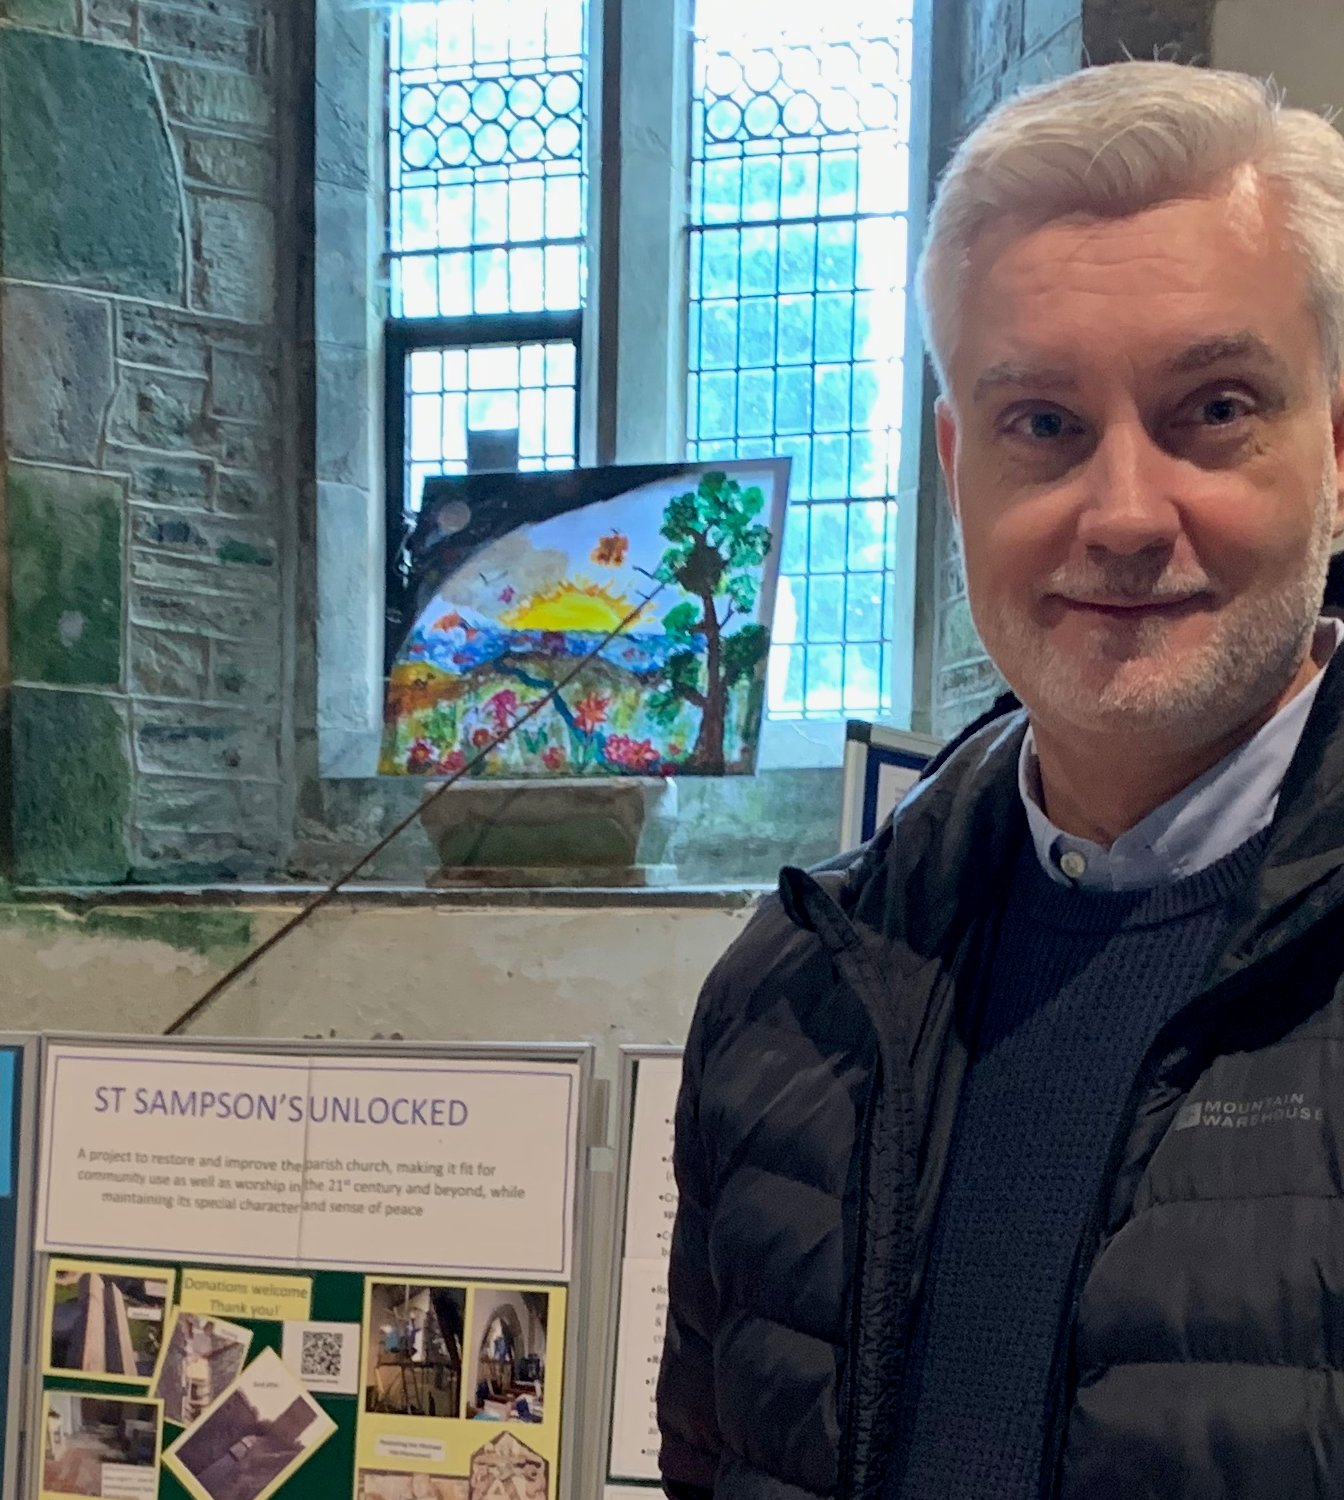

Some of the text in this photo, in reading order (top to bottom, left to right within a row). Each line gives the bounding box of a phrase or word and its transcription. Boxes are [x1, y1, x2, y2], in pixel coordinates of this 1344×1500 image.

[94, 1085, 469, 1127] ST SAMPSON'S UNLOCKED
[77, 1147, 497, 1178] A project to restore and improve the parish church, making it fit for
[77, 1169, 146, 1186] community
[149, 1174, 171, 1186] use
[173, 1176, 187, 1187] as
[190, 1174, 215, 1188] well
[218, 1178, 233, 1190] as
[235, 1178, 286, 1194] worship
[288, 1181, 301, 1193] in
[305, 1179, 325, 1192] the
[353, 1180, 402, 1197] century
[405, 1182, 430, 1196] and
[434, 1183, 486, 1200] beyond,
[490, 1185, 526, 1200] while
[101, 1191, 424, 1218] maintaining its special character and sense of peace
[184, 1277, 309, 1299] Donations welcome
[210, 1299, 279, 1317] Thank you!
